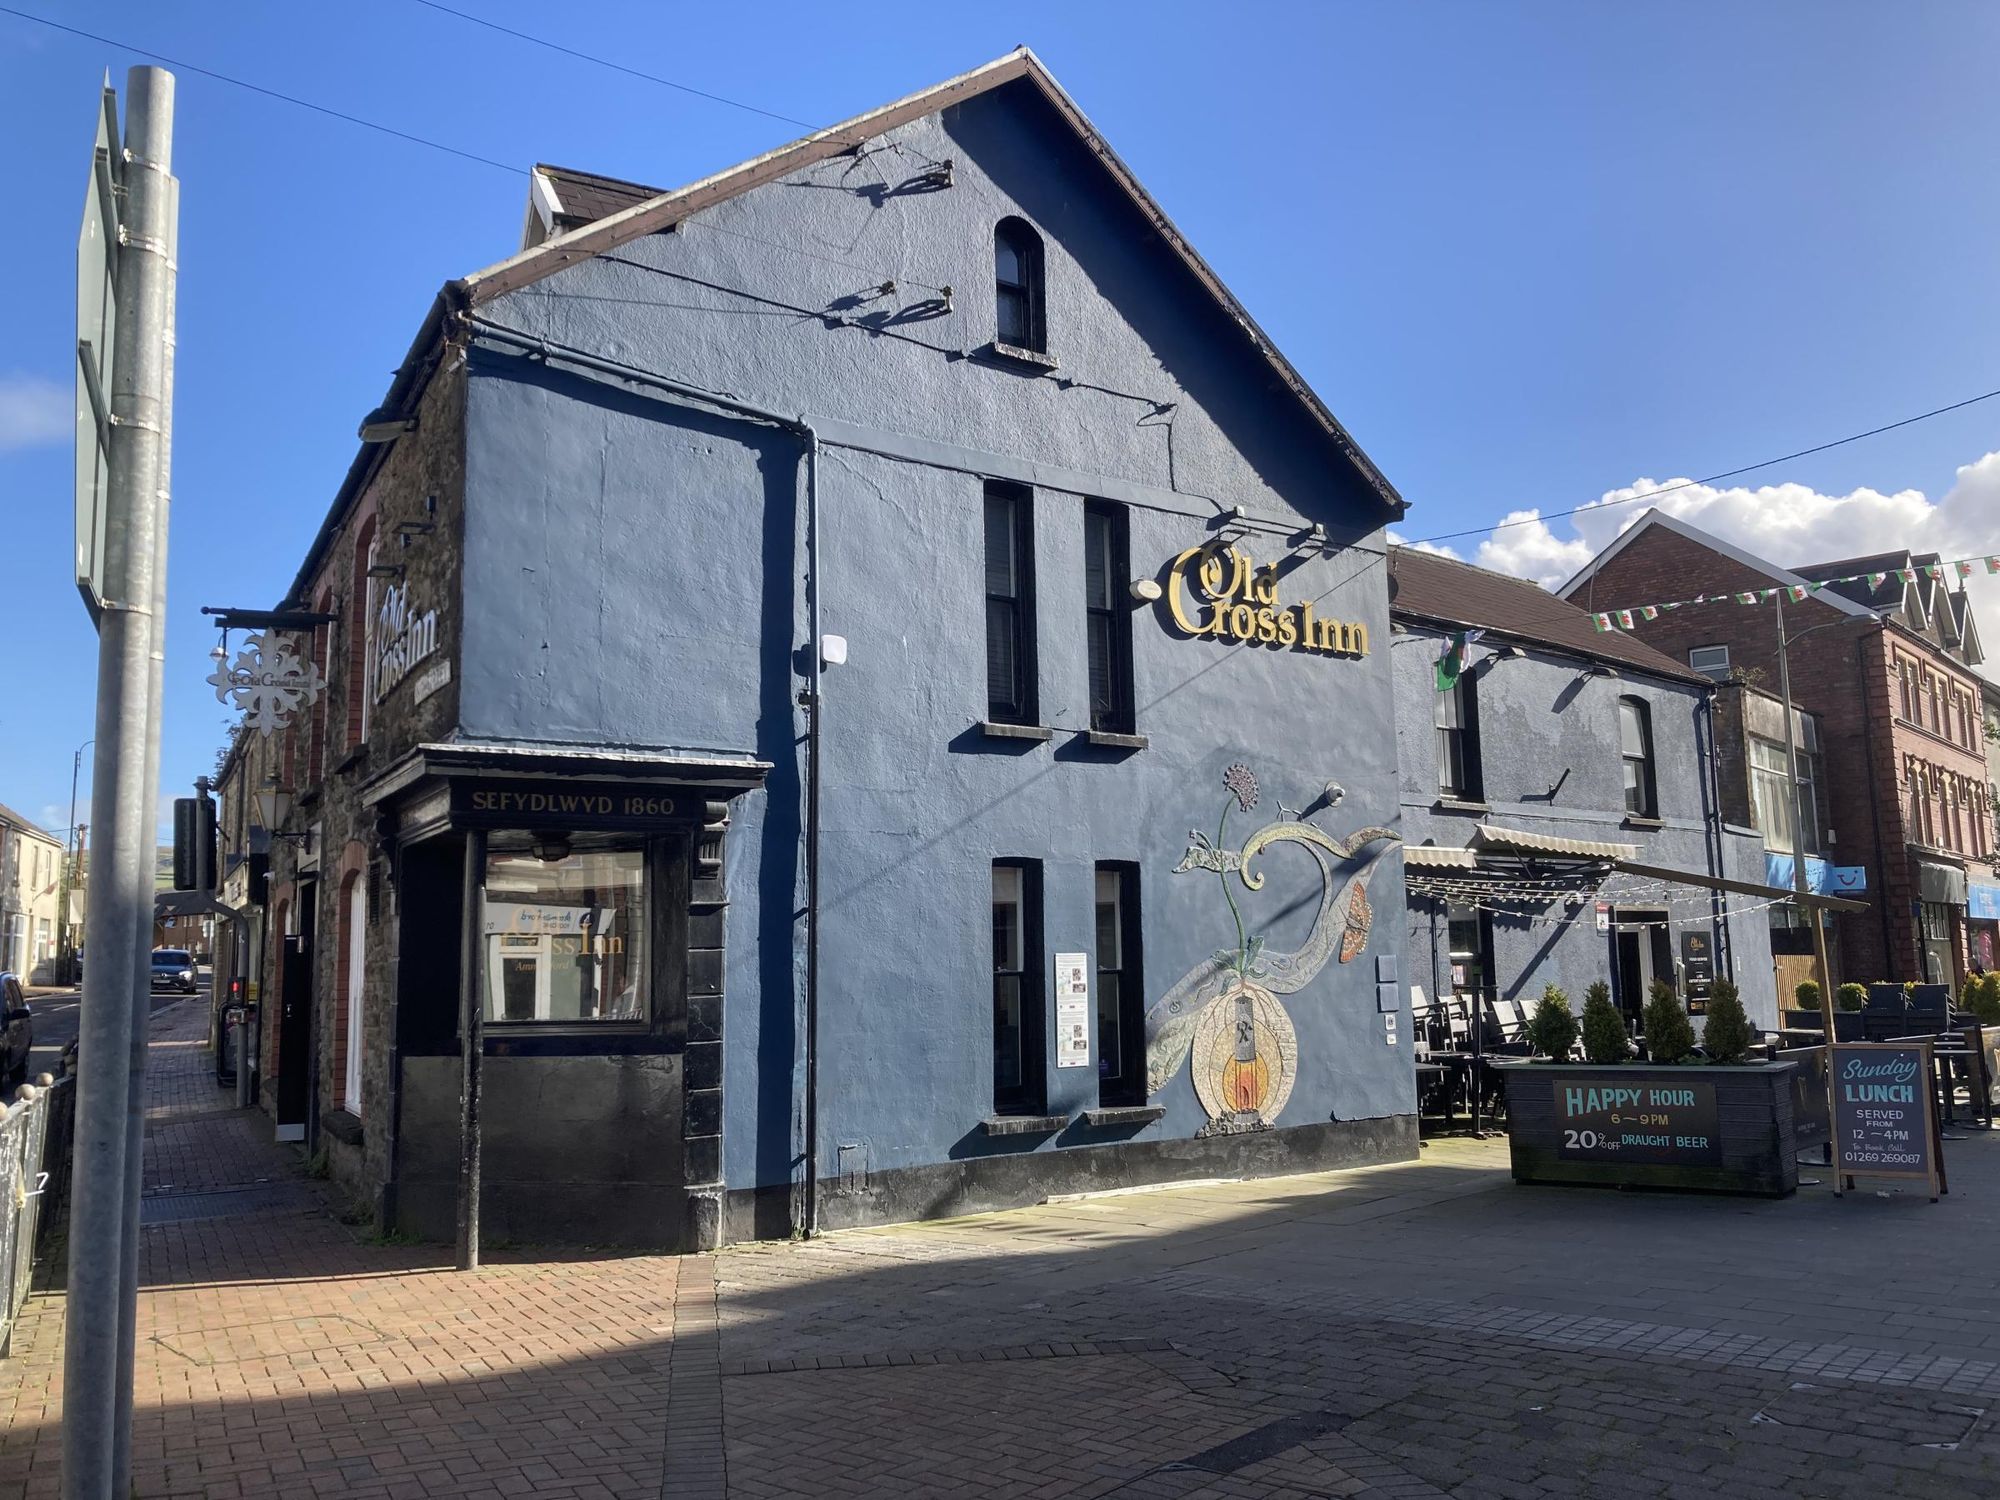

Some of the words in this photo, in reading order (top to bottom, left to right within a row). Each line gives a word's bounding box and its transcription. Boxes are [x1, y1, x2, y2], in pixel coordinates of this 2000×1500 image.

[1199, 541, 1281, 606] Old
[1168, 541, 1298, 645] Cross
[1301, 600, 1371, 655] Inn
[472, 791, 613, 815] SEFYDLWYD
[624, 797, 675, 816] 1860
[1843, 1058, 1917, 1083] Sunday
[1565, 1087, 1642, 1117] HAPPY
[1650, 1089, 1695, 1106] HOUR
[1845, 1084, 1914, 1103] LUNCH
[1856, 1109, 1904, 1120] SERVED
[1866, 1120, 1893, 1128] FROM
[1564, 1129, 1607, 1149] 20%
[1607, 1141, 1621, 1150] OFF
[1621, 1133, 1671, 1147] DRAUGHT
[1676, 1136, 1709, 1149] BEER
[1845, 1151, 1879, 1162] 01269
[1881, 1152, 1921, 1164] 269087
